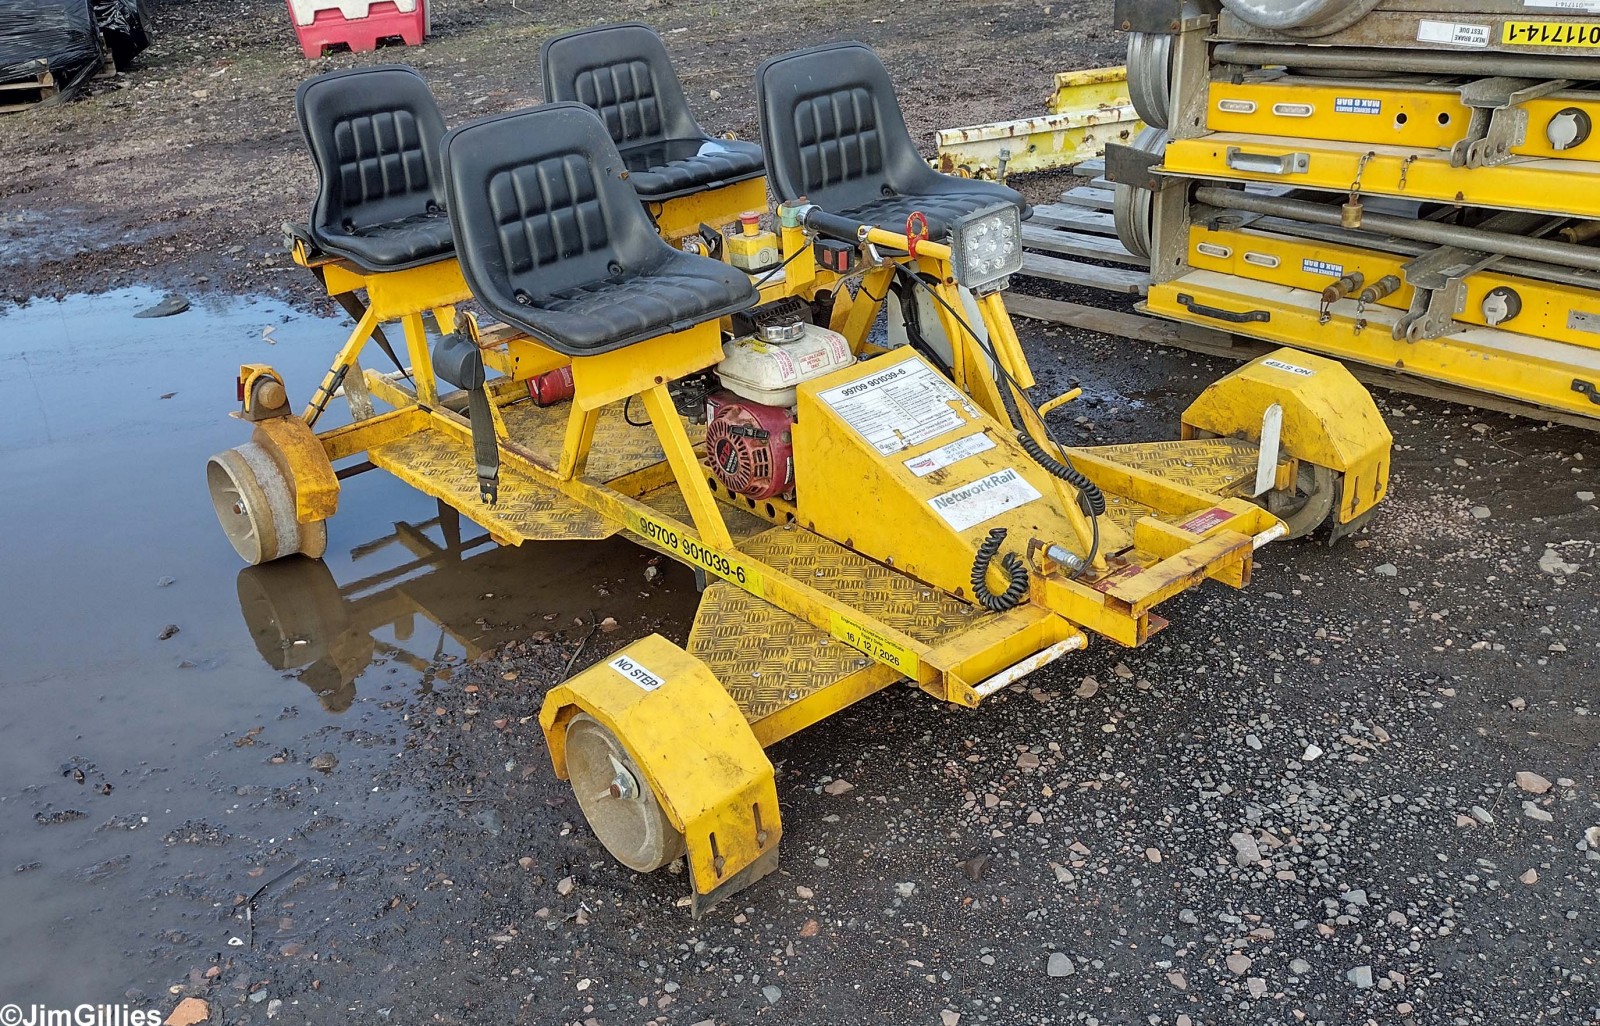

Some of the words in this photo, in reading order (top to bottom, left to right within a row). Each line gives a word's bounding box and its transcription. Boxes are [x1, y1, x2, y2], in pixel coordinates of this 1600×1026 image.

[1509, 24, 1600, 44] 011714-1
[1336, 98, 1353, 106] BAR
[1361, 99, 1380, 107] MAX
[1304, 259, 1319, 268] BAR
[1326, 263, 1343, 272] MAX
[1265, 361, 1293, 371] STEP
[841, 383, 868, 396] 99709
[867, 368, 906, 387] 901039-6
[934, 469, 1016, 509] NetworkRail
[640, 517, 678, 549] 99709
[682, 539, 746, 583] 901039-6
[841, 616, 861, 630] Engineering
[862, 627, 883, 641] Acceptance
[861, 632, 873, 642] Expiry
[846, 632, 855, 642] 16
[864, 640, 872, 651] 12
[879, 649, 900, 666] 2026
[614, 659, 633, 671] NO
[630, 669, 659, 686] STEP
